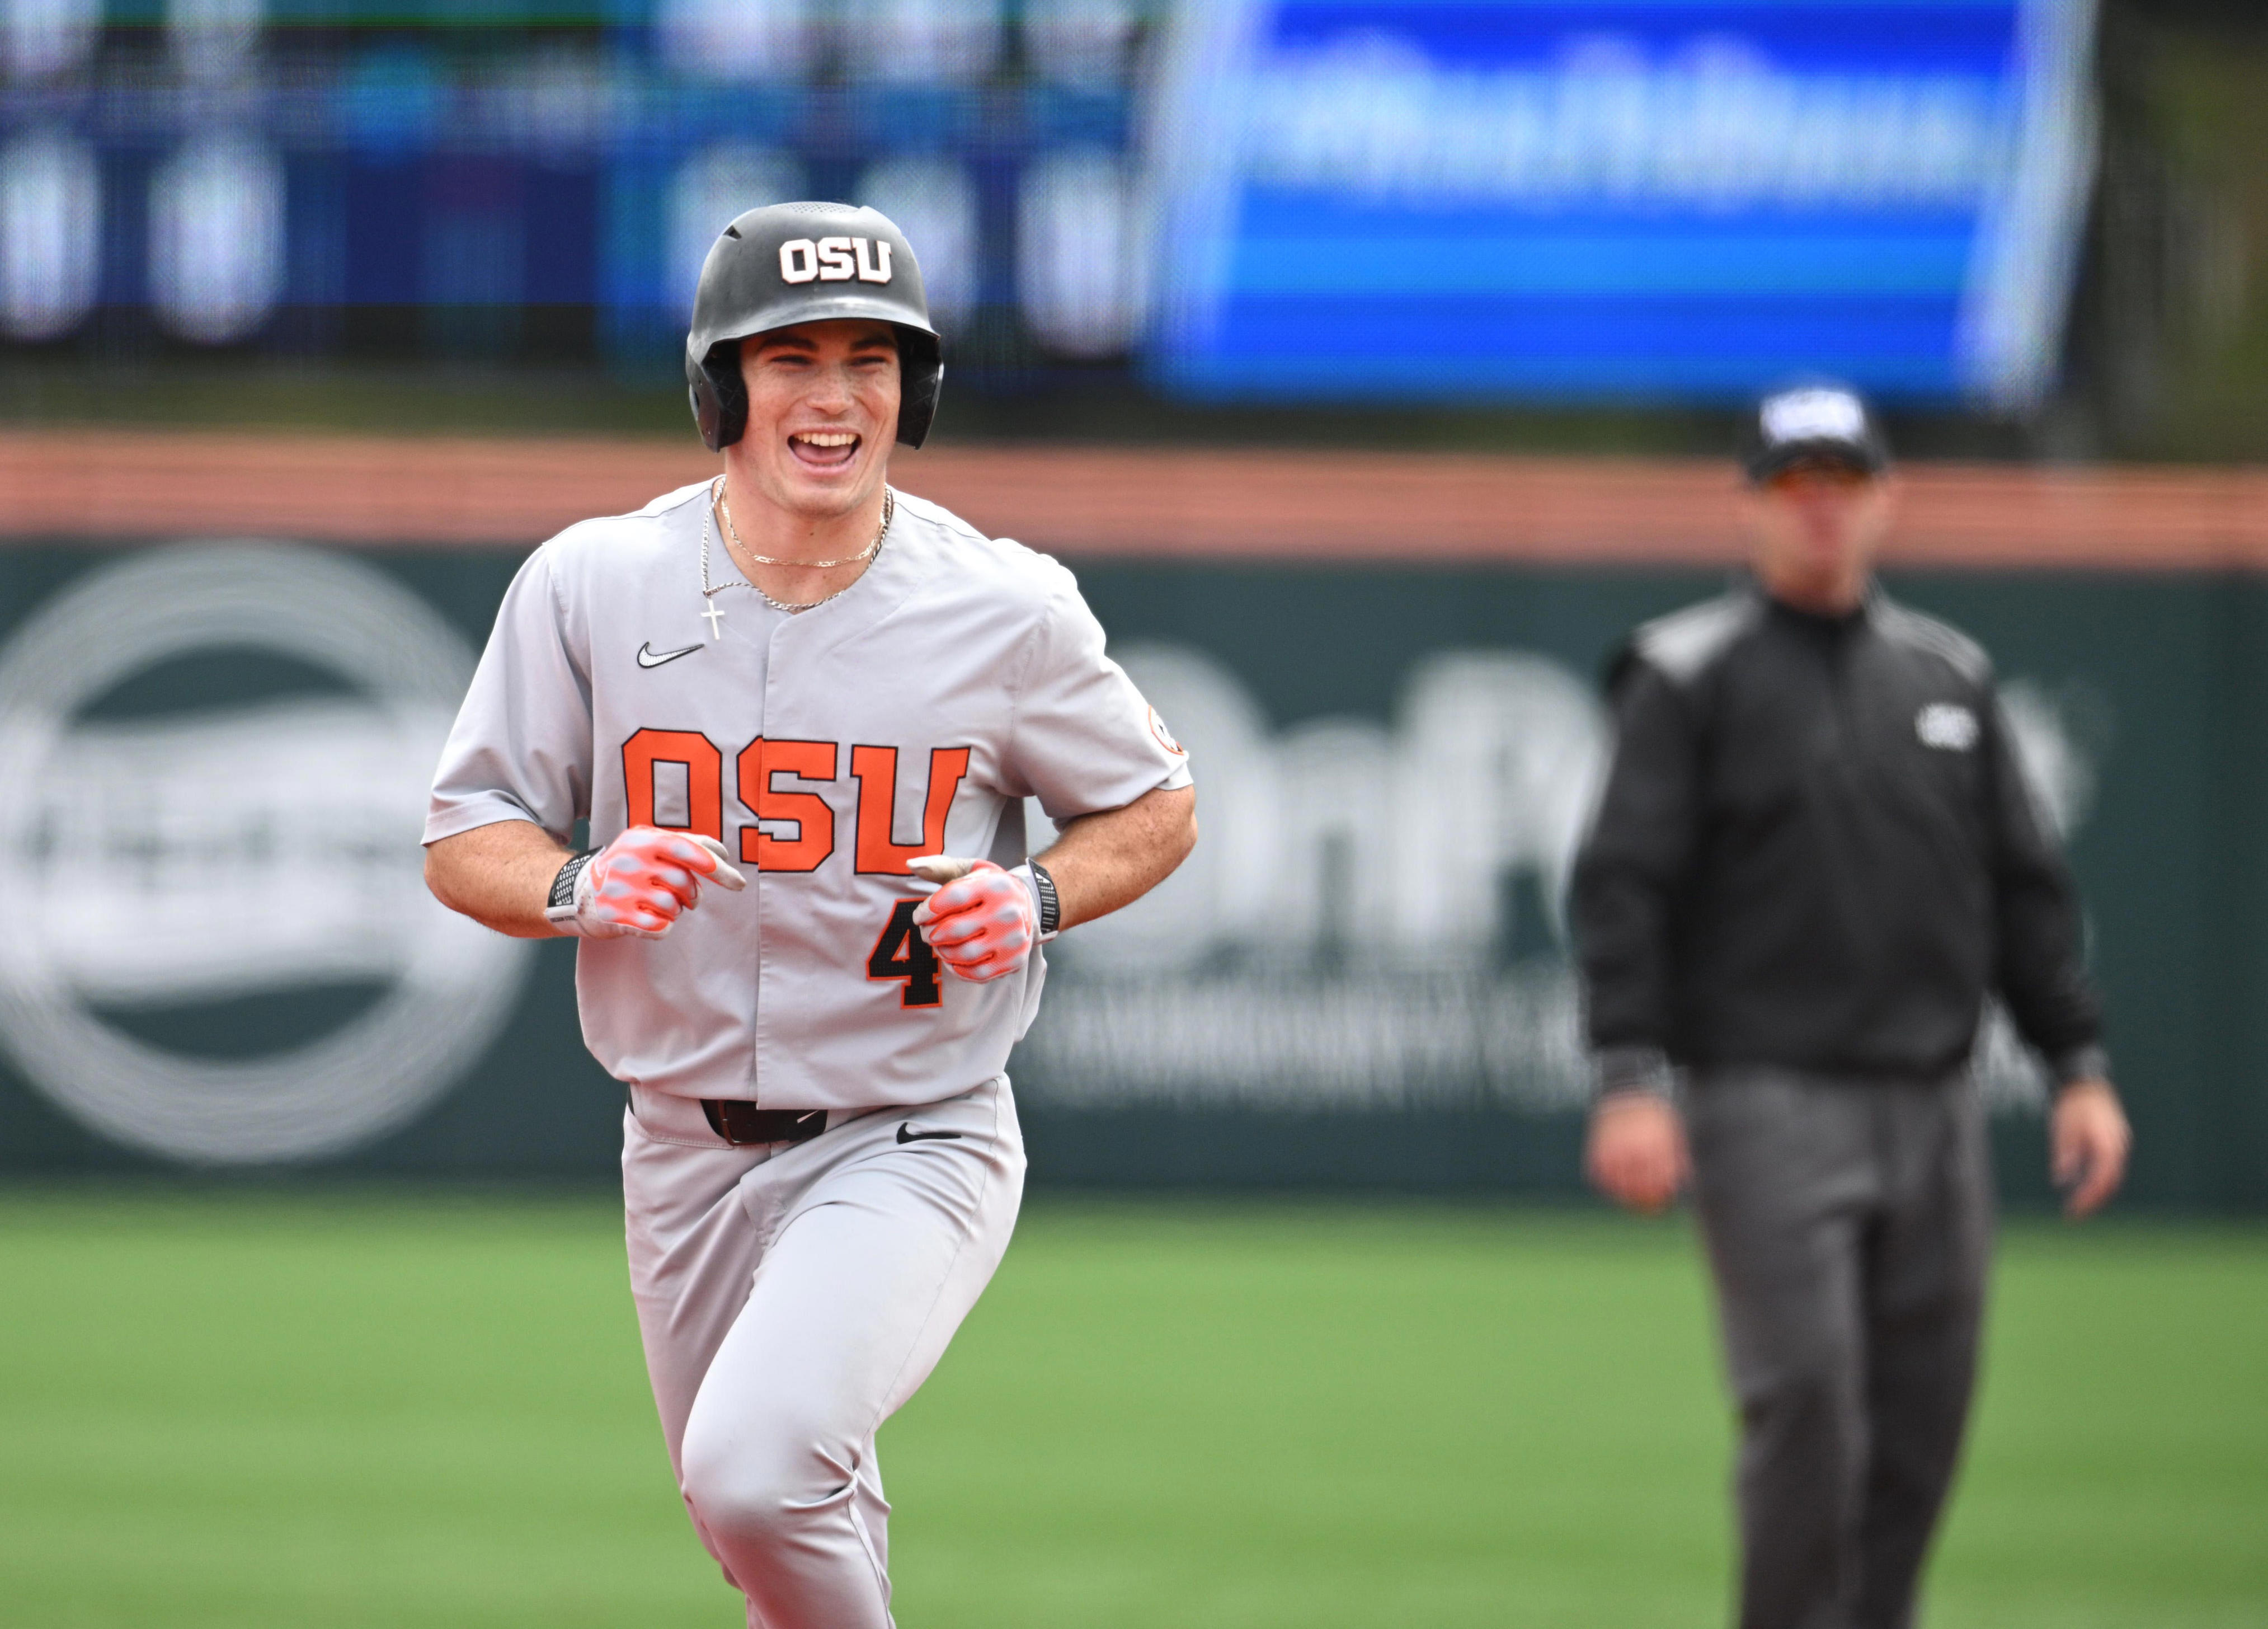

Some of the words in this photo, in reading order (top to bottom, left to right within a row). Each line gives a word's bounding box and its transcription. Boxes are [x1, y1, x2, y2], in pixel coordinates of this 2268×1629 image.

[779, 237, 892, 285] OSU
[622, 727, 971, 875] OSU
[865, 896, 943, 1010] 4
